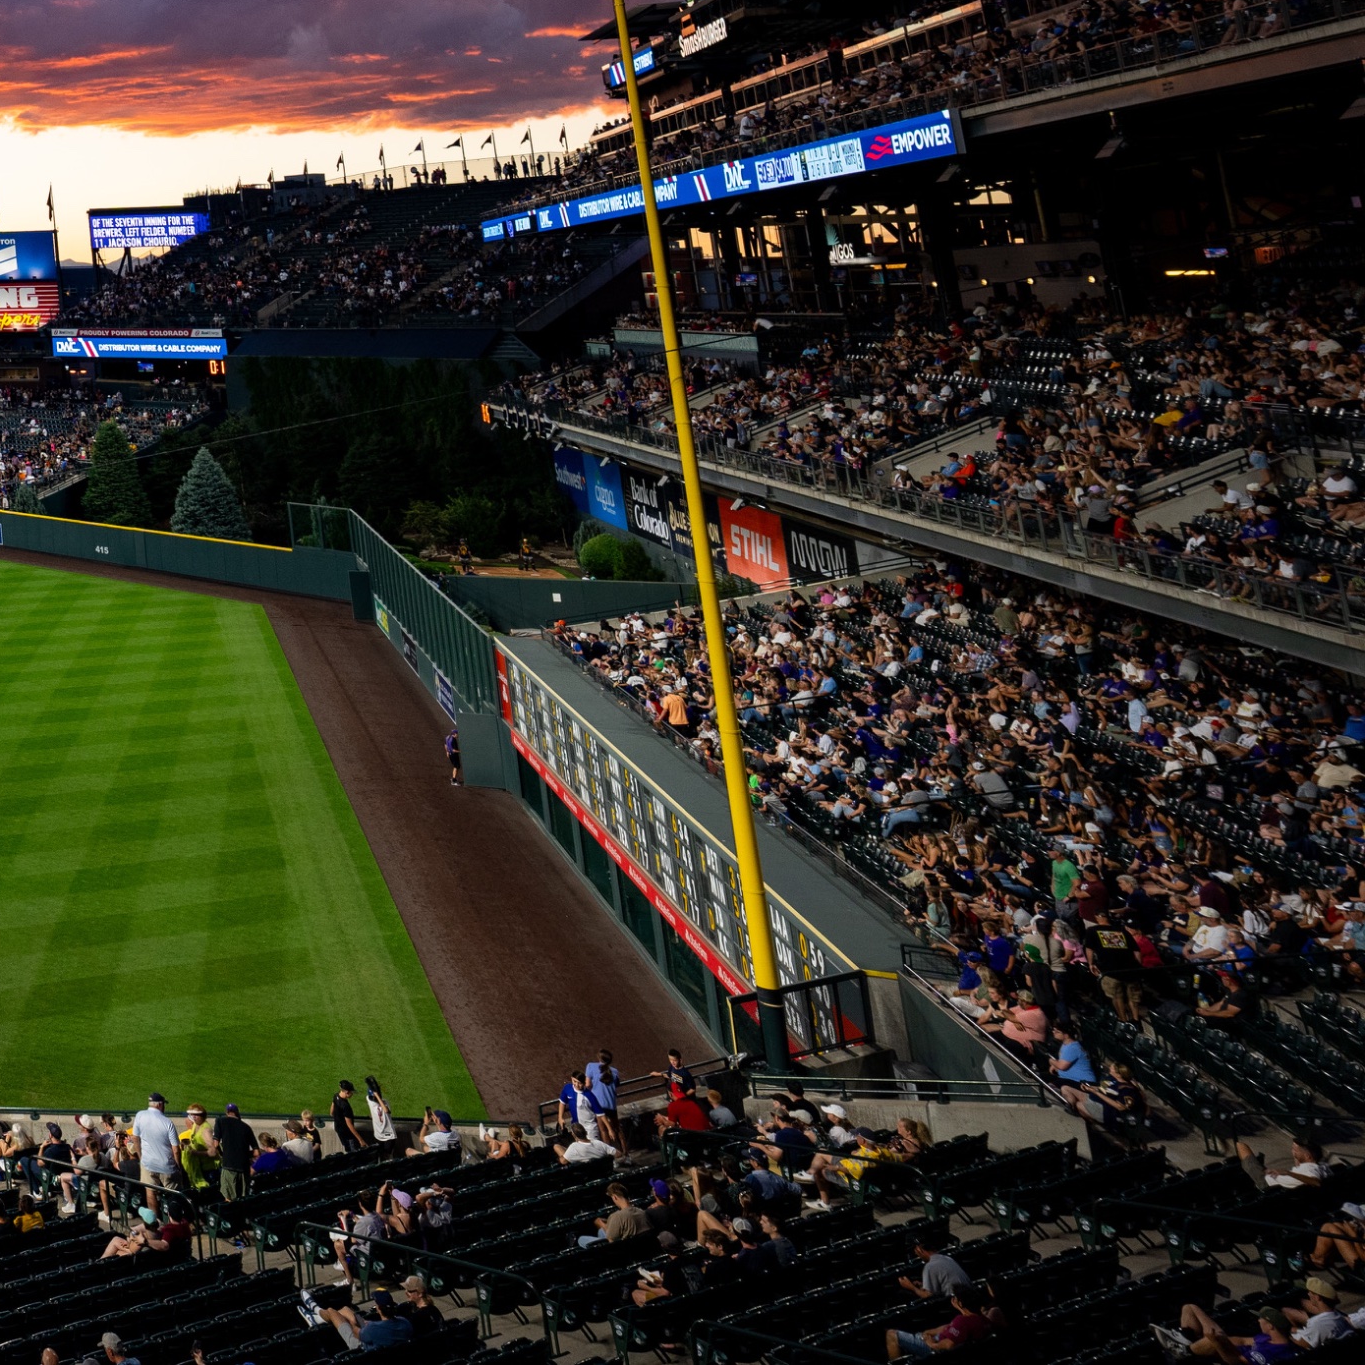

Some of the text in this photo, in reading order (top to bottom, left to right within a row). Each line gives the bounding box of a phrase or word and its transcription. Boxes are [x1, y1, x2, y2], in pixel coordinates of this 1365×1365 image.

[891, 124, 951, 154] EMPOWER
[92, 215, 194, 228] OF THE SEVENTH INNING FOR THE
[93, 228, 124, 238] BREWERS,
[126, 228, 139, 237] LEFT
[168, 226, 195, 236] NUMBER
[109, 237, 142, 247] JACKSON
[99, 343, 139, 352] DISTRIBUTOR
[140, 344, 157, 353] WIRE
[163, 345, 186, 353] CABLE
[186, 345, 221, 354] COMPANY
[555, 463, 583, 491] Southwest
[630, 477, 658, 508] Bank of
[635, 505, 669, 540] Colorado
[669, 501, 687, 531] BLUE
[95, 545, 109, 554] 415
[731, 524, 780, 572] STIHL
[678, 818, 689, 846] 34
[674, 838, 680, 859] 7
[682, 845, 693, 872] 48
[705, 844, 719, 874] DET
[728, 866, 736, 890] 3
[686, 874, 697, 901] 41
[709, 872, 740, 919] MIN 5
[690, 899, 700, 926] 17
[717, 928, 730, 958] KC
[741, 954, 749, 980] 0
[769, 904, 825, 975] LAA 0 59
[774, 936, 796, 975] OAK
